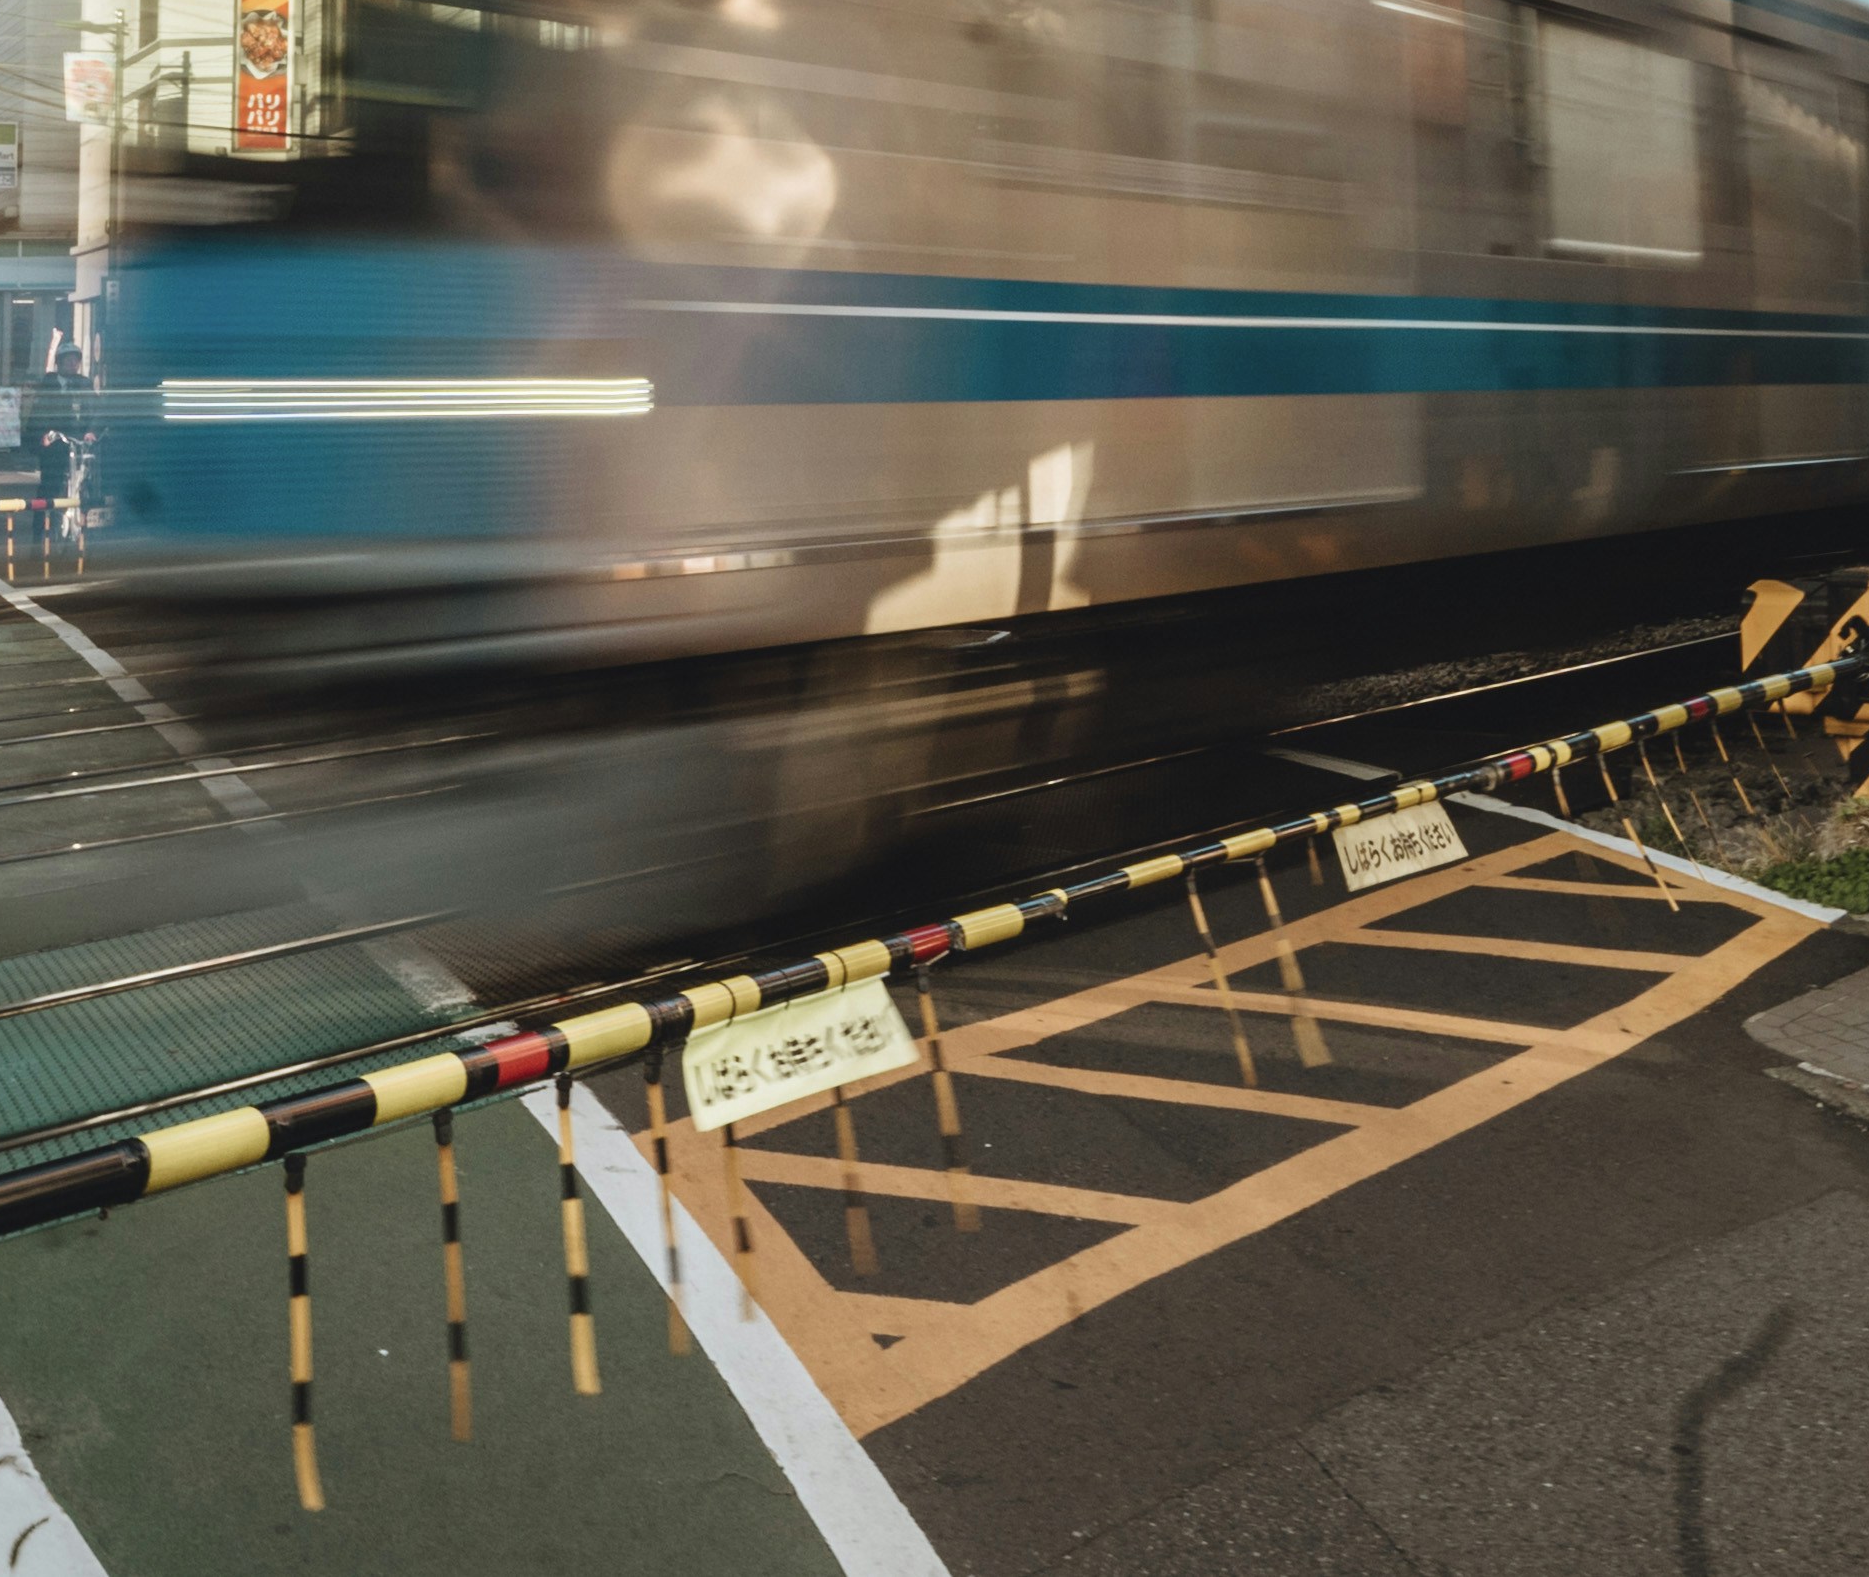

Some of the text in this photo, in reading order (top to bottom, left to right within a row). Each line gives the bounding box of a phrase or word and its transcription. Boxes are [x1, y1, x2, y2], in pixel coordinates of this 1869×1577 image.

[247, 93, 281, 110] パリ
[246, 109, 280, 126] パリ
[1343, 821, 1455, 875] しばらくお待ちください
